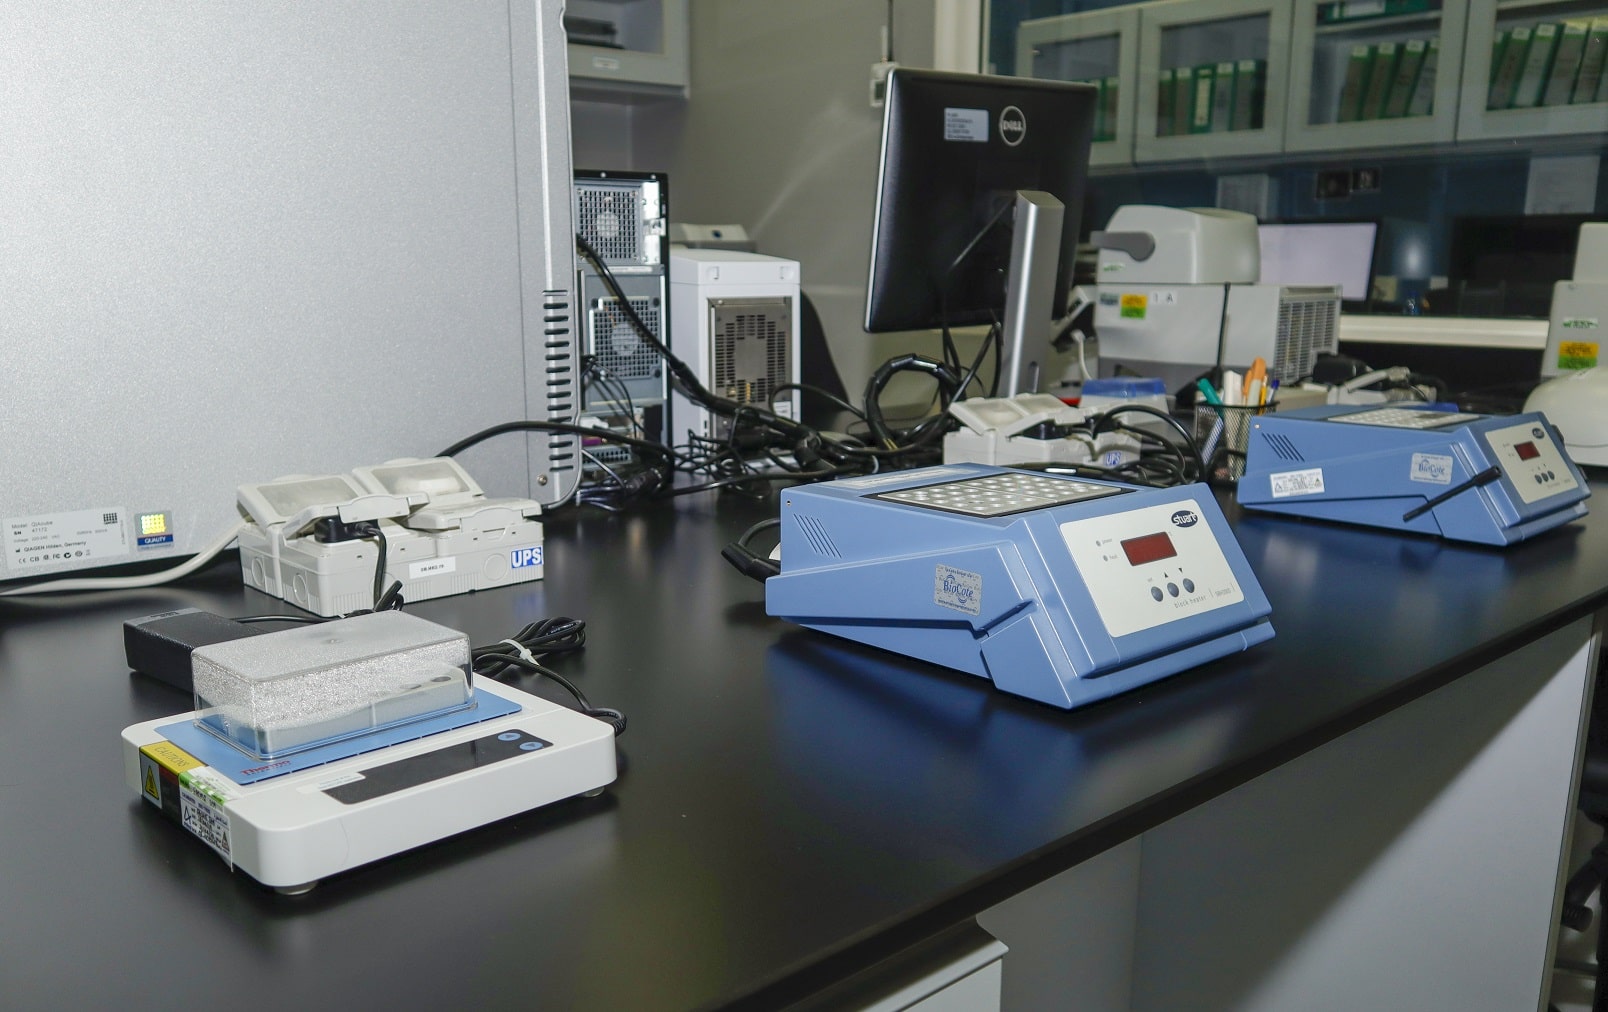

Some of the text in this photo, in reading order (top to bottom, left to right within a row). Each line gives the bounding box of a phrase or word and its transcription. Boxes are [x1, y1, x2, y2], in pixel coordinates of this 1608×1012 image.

[1106, 451, 1121, 466] UPS
[1173, 511, 1196, 525] stuart
[511, 548, 542, 568] UPS
[943, 579, 974, 598] BioCote
